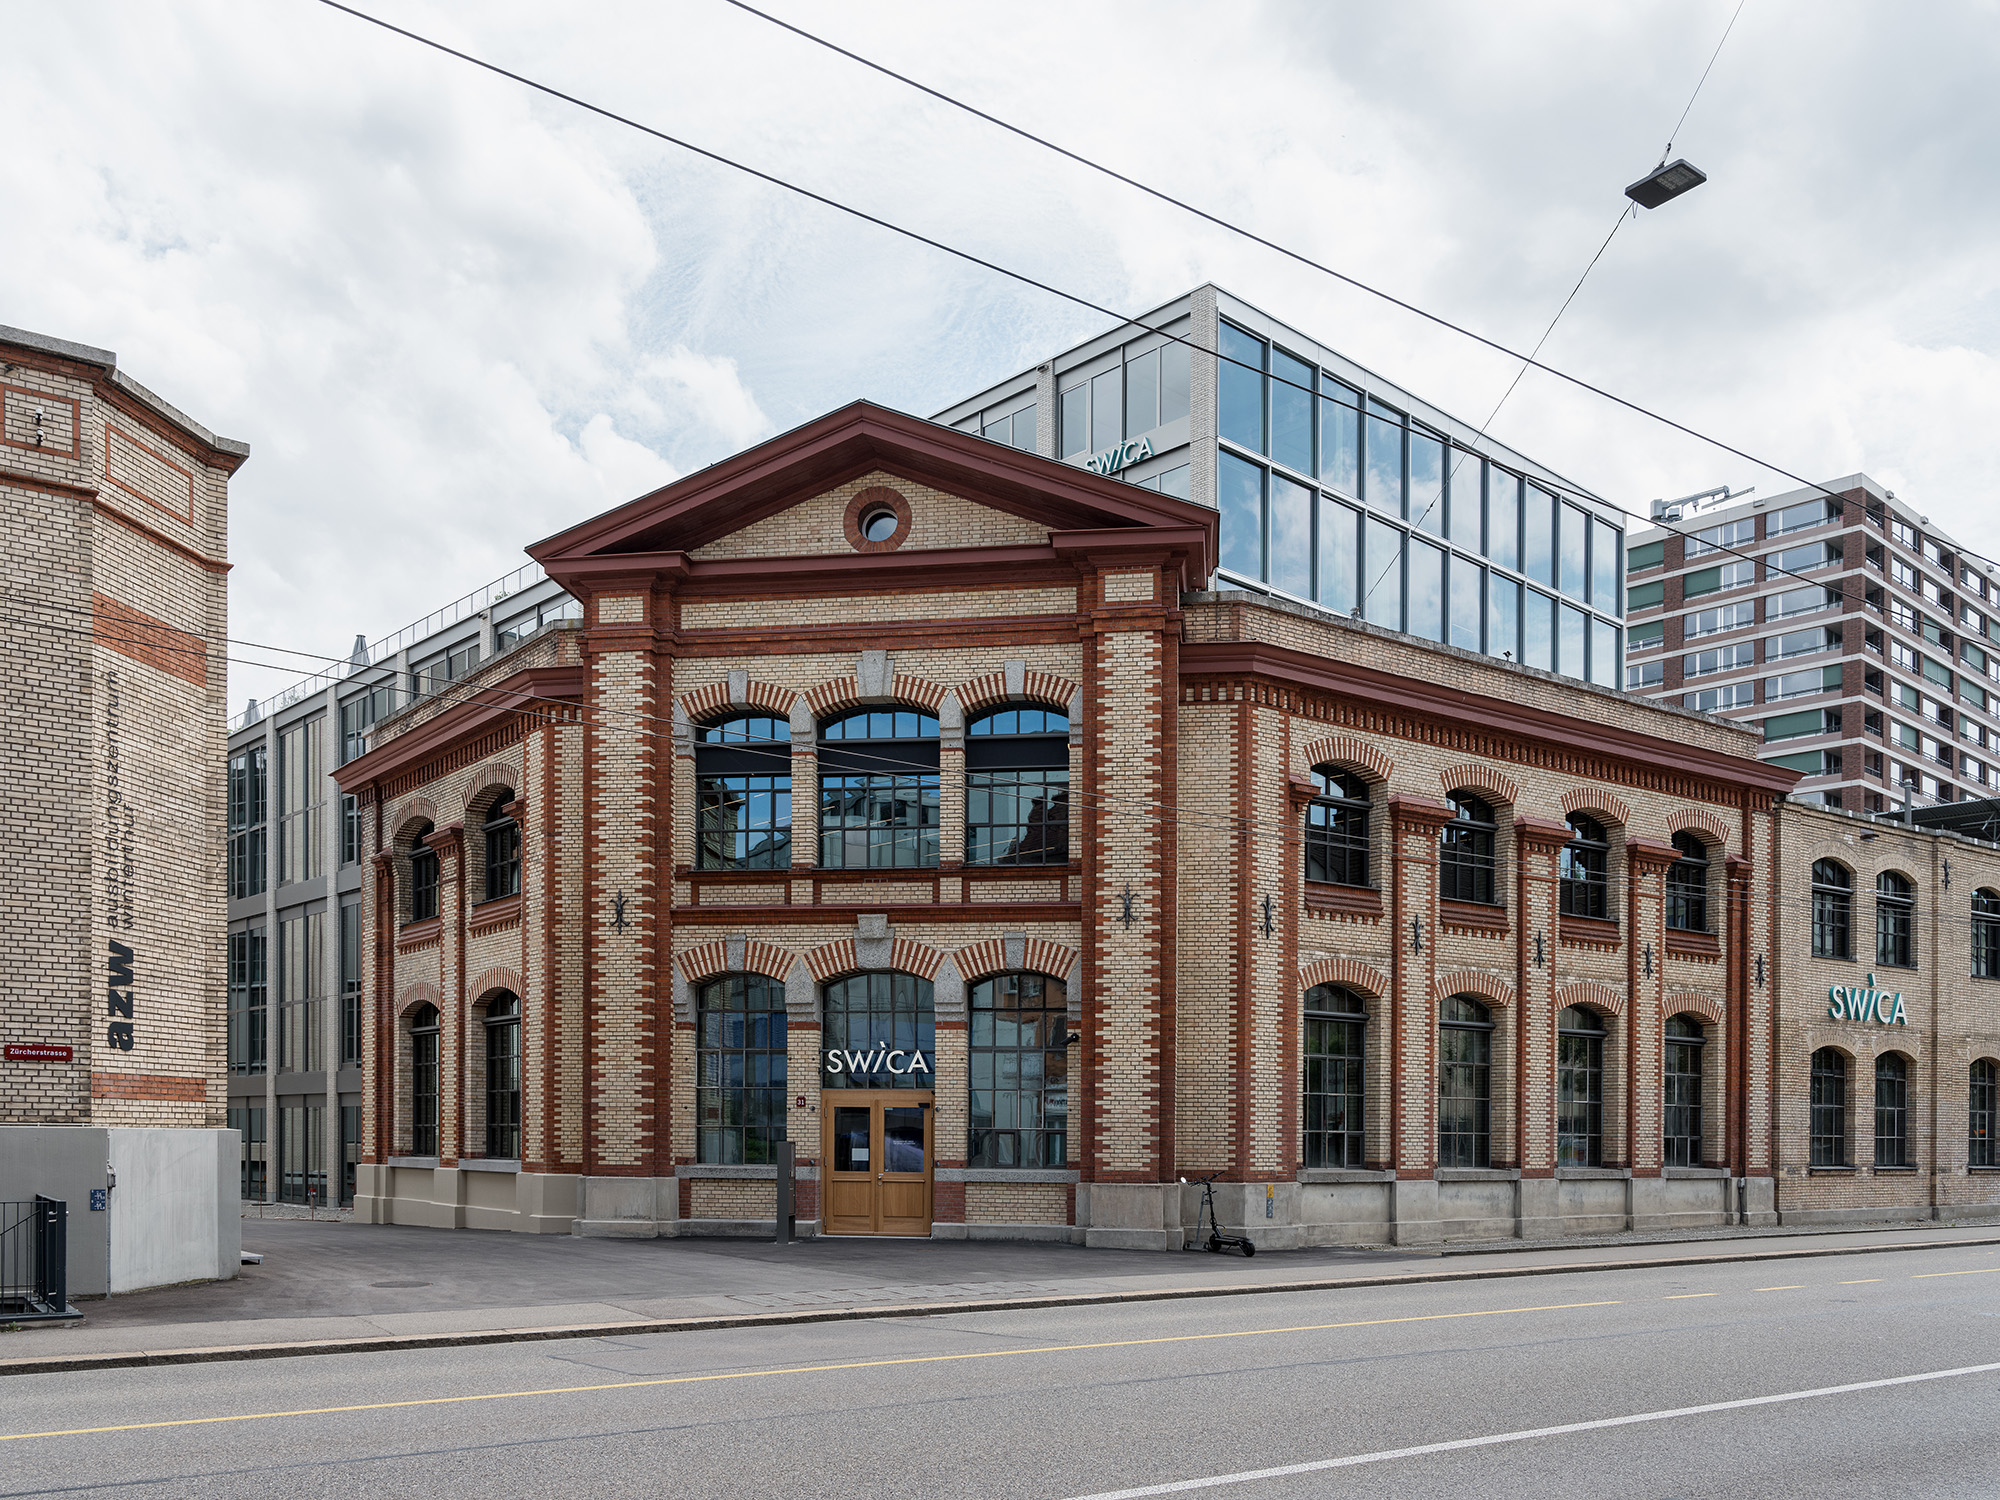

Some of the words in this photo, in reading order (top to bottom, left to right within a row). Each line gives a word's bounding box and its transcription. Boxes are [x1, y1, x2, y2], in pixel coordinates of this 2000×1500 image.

[104, 671, 122, 928] ausbildungszentrum
[120, 803, 135, 930] winterthur
[9, 1047, 67, 1057] Zürcherstrasse
[108, 939, 134, 1051] azw
